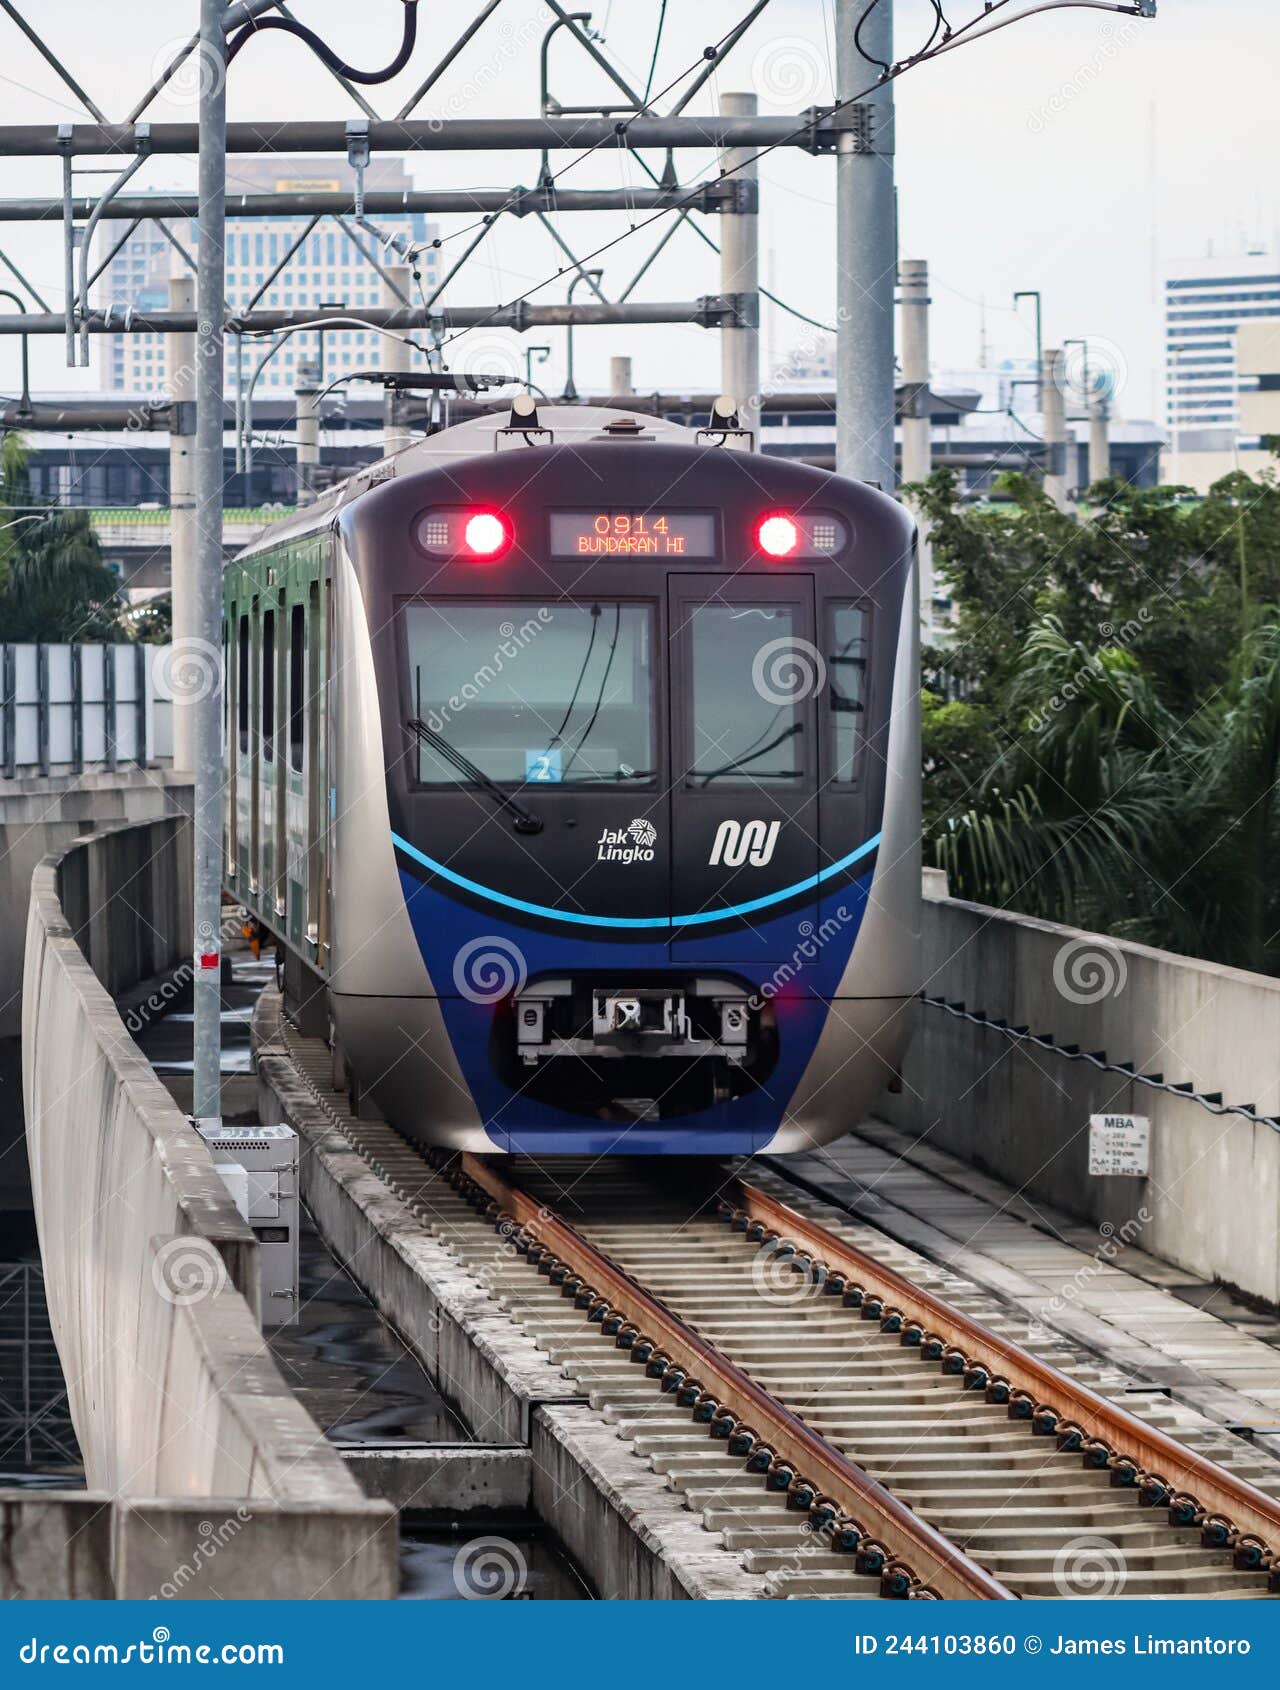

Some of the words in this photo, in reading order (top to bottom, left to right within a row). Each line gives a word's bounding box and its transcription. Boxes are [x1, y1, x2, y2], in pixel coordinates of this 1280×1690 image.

[594, 516, 668, 534] 0914
[578, 537, 658, 553] BUNDARAN
[666, 537, 686, 553] HI
[598, 828, 628, 844] Jak
[597, 845, 655, 865] Lingko
[1104, 1118, 1134, 1128] MBA
